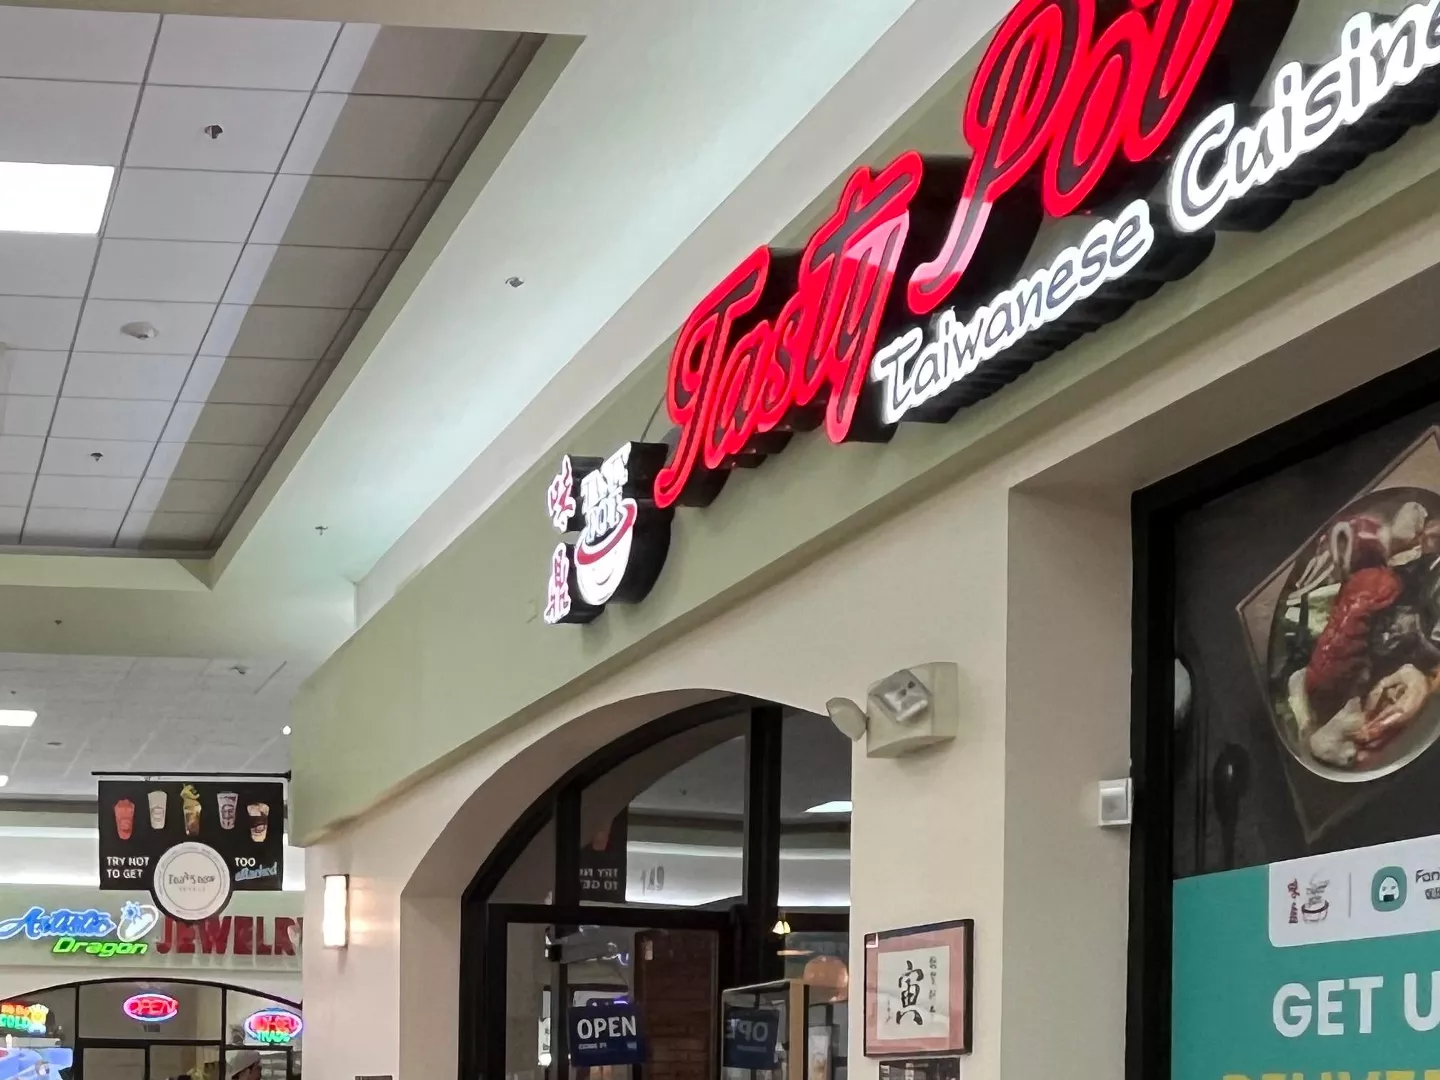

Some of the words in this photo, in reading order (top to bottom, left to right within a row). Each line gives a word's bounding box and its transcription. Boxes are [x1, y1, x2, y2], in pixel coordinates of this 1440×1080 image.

[871, 198, 1156, 425] Taiwanese
[654, 150, 923, 510] Tasty
[107, 856, 126, 867] TRY
[129, 856, 150, 867] NOT
[234, 857, 257, 867] TOO
[107, 868, 121, 879] TO
[123, 868, 143, 879] GET
[52, 936, 148, 957] Dragon
[155, 915, 303, 956] JEWELR
[129, 999, 180, 1017] OPEN
[1272, 975, 1384, 1039] GET
[1403, 969, 1440, 1033] U
[576, 1015, 637, 1040] OPEN
